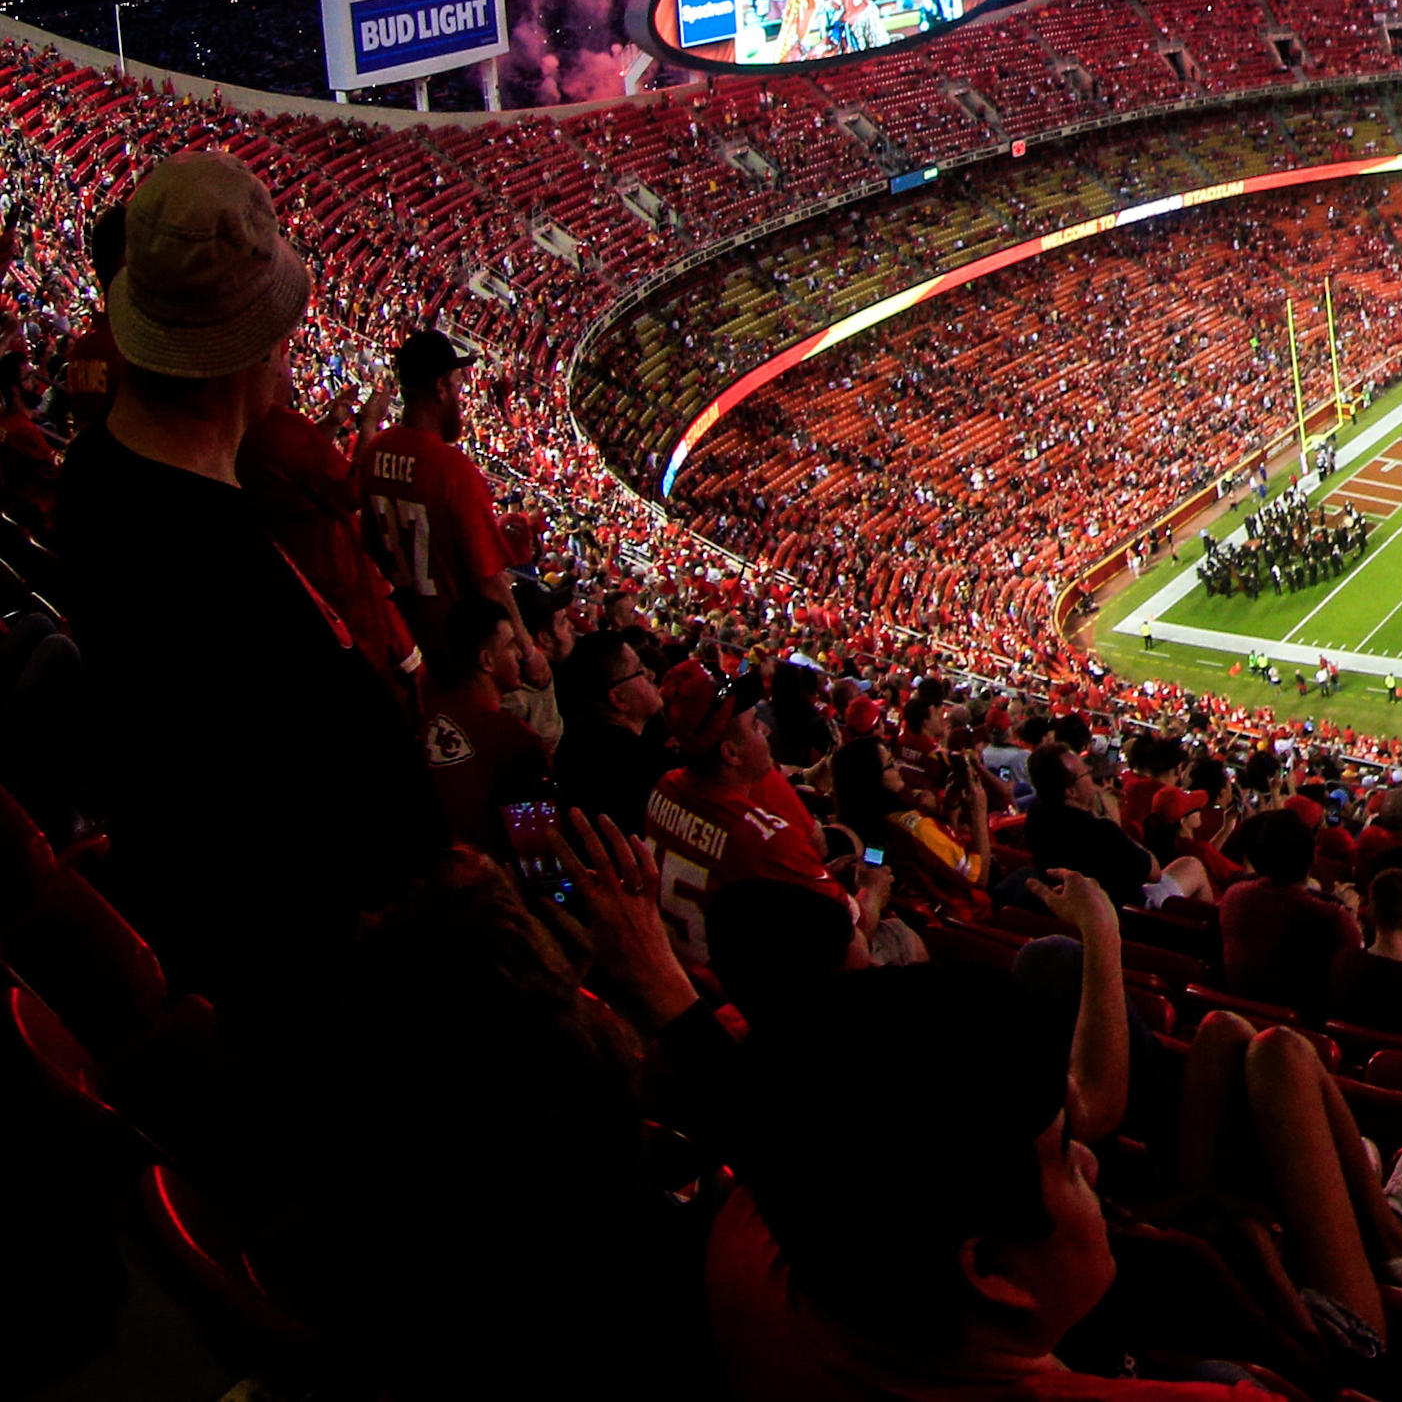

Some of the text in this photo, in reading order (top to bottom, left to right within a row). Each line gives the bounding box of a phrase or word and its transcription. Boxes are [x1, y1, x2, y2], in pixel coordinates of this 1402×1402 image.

[360, 13, 415, 52] BUD
[1041, 180, 1245, 250] WELCOME TO STADIUM
[374, 449, 417, 485] KELCE
[645, 835, 711, 964] 5
